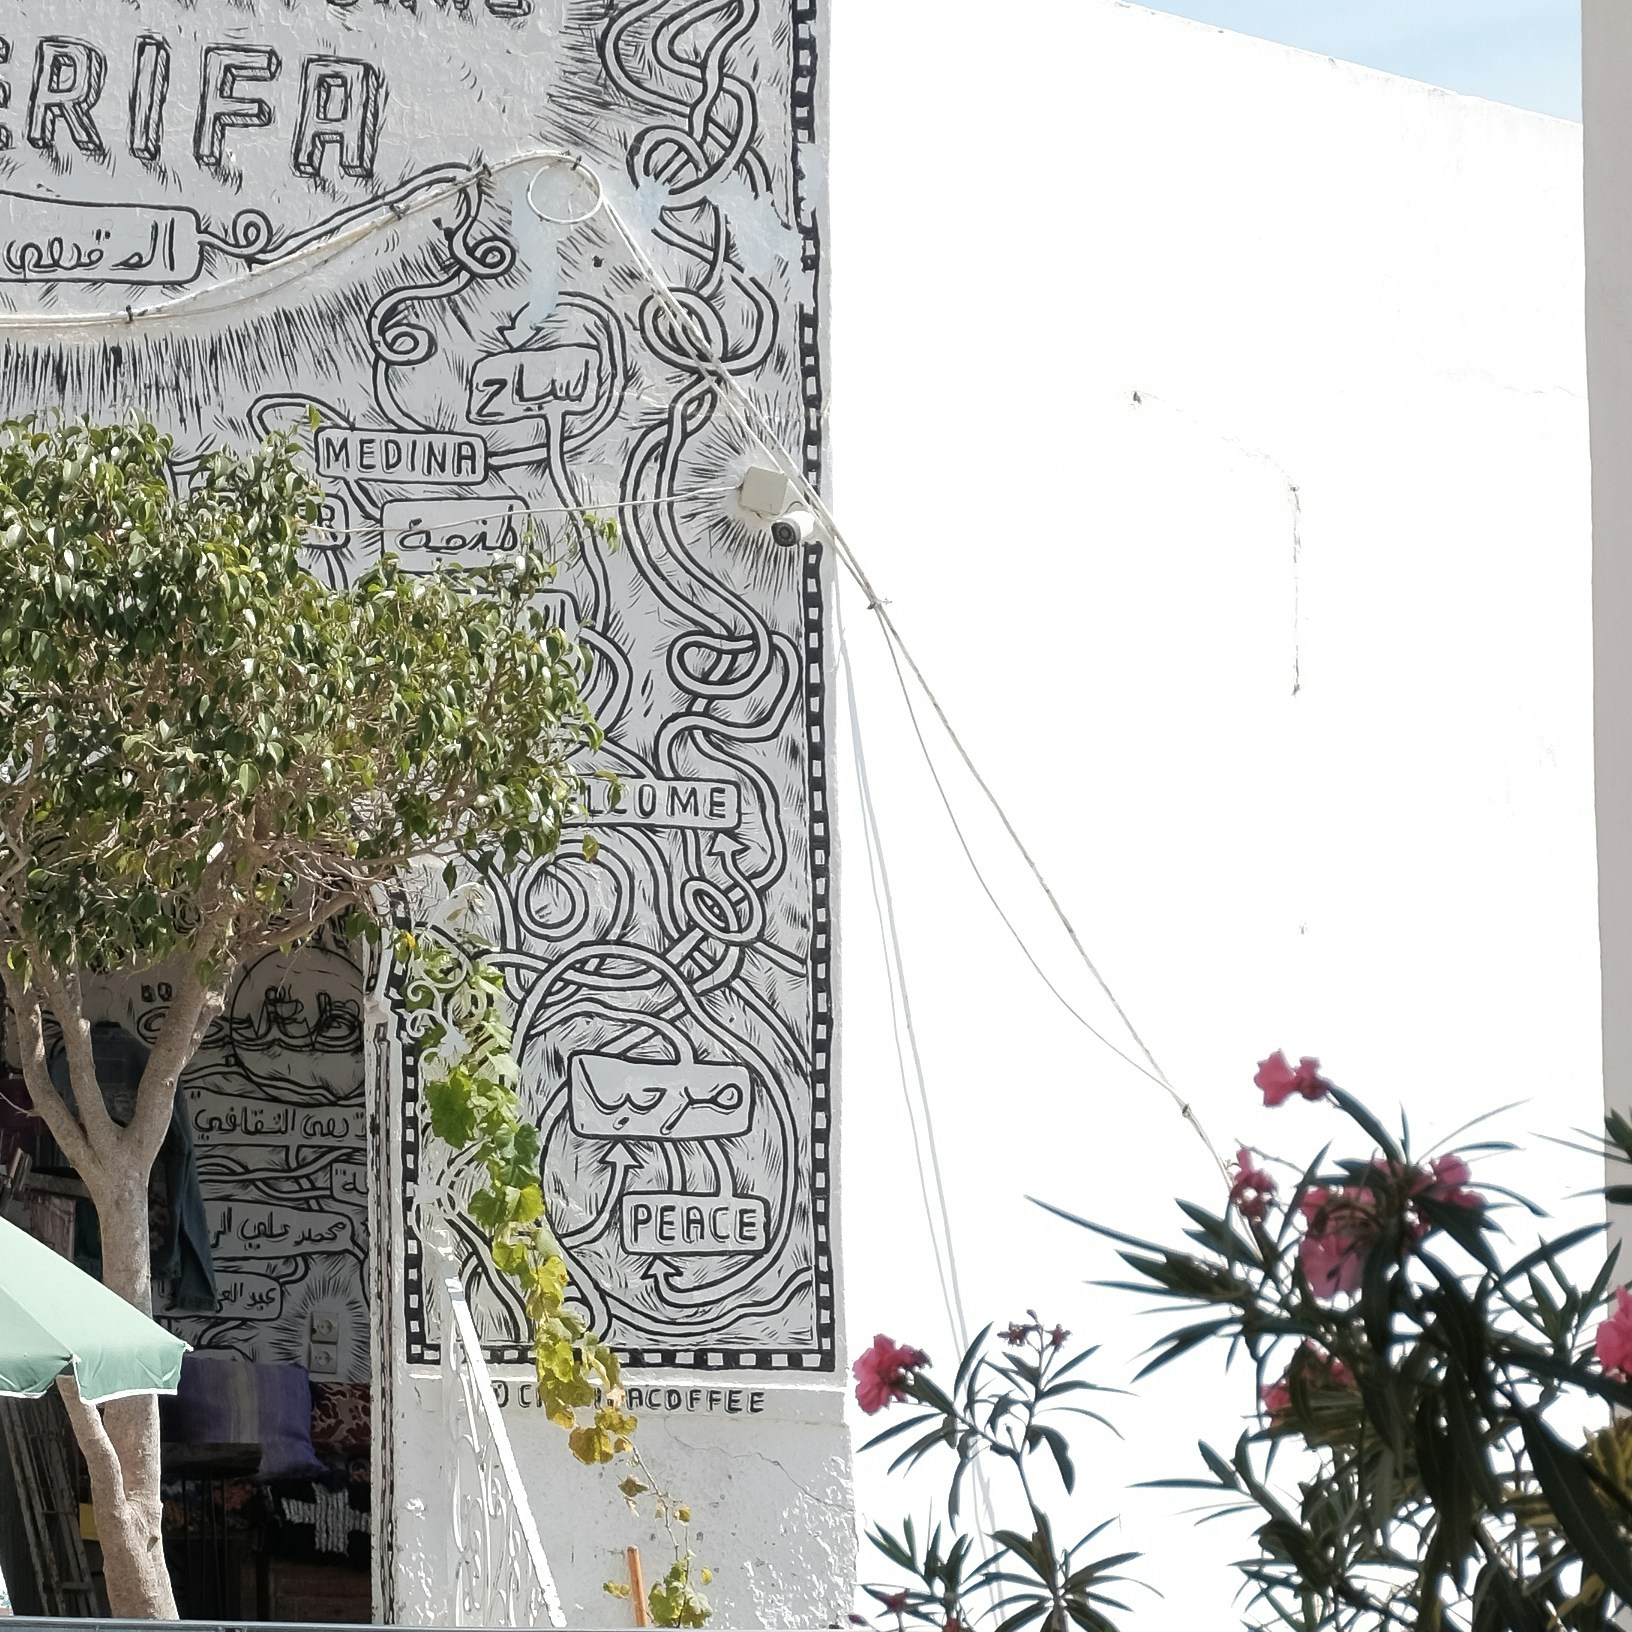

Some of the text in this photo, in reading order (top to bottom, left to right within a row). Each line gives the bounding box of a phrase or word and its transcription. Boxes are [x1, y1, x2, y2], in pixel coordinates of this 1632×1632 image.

[323, 436, 477, 476] MEDINA
[579, 1057, 743, 1134] مرحبا
[631, 1204, 757, 1244] PEACE
